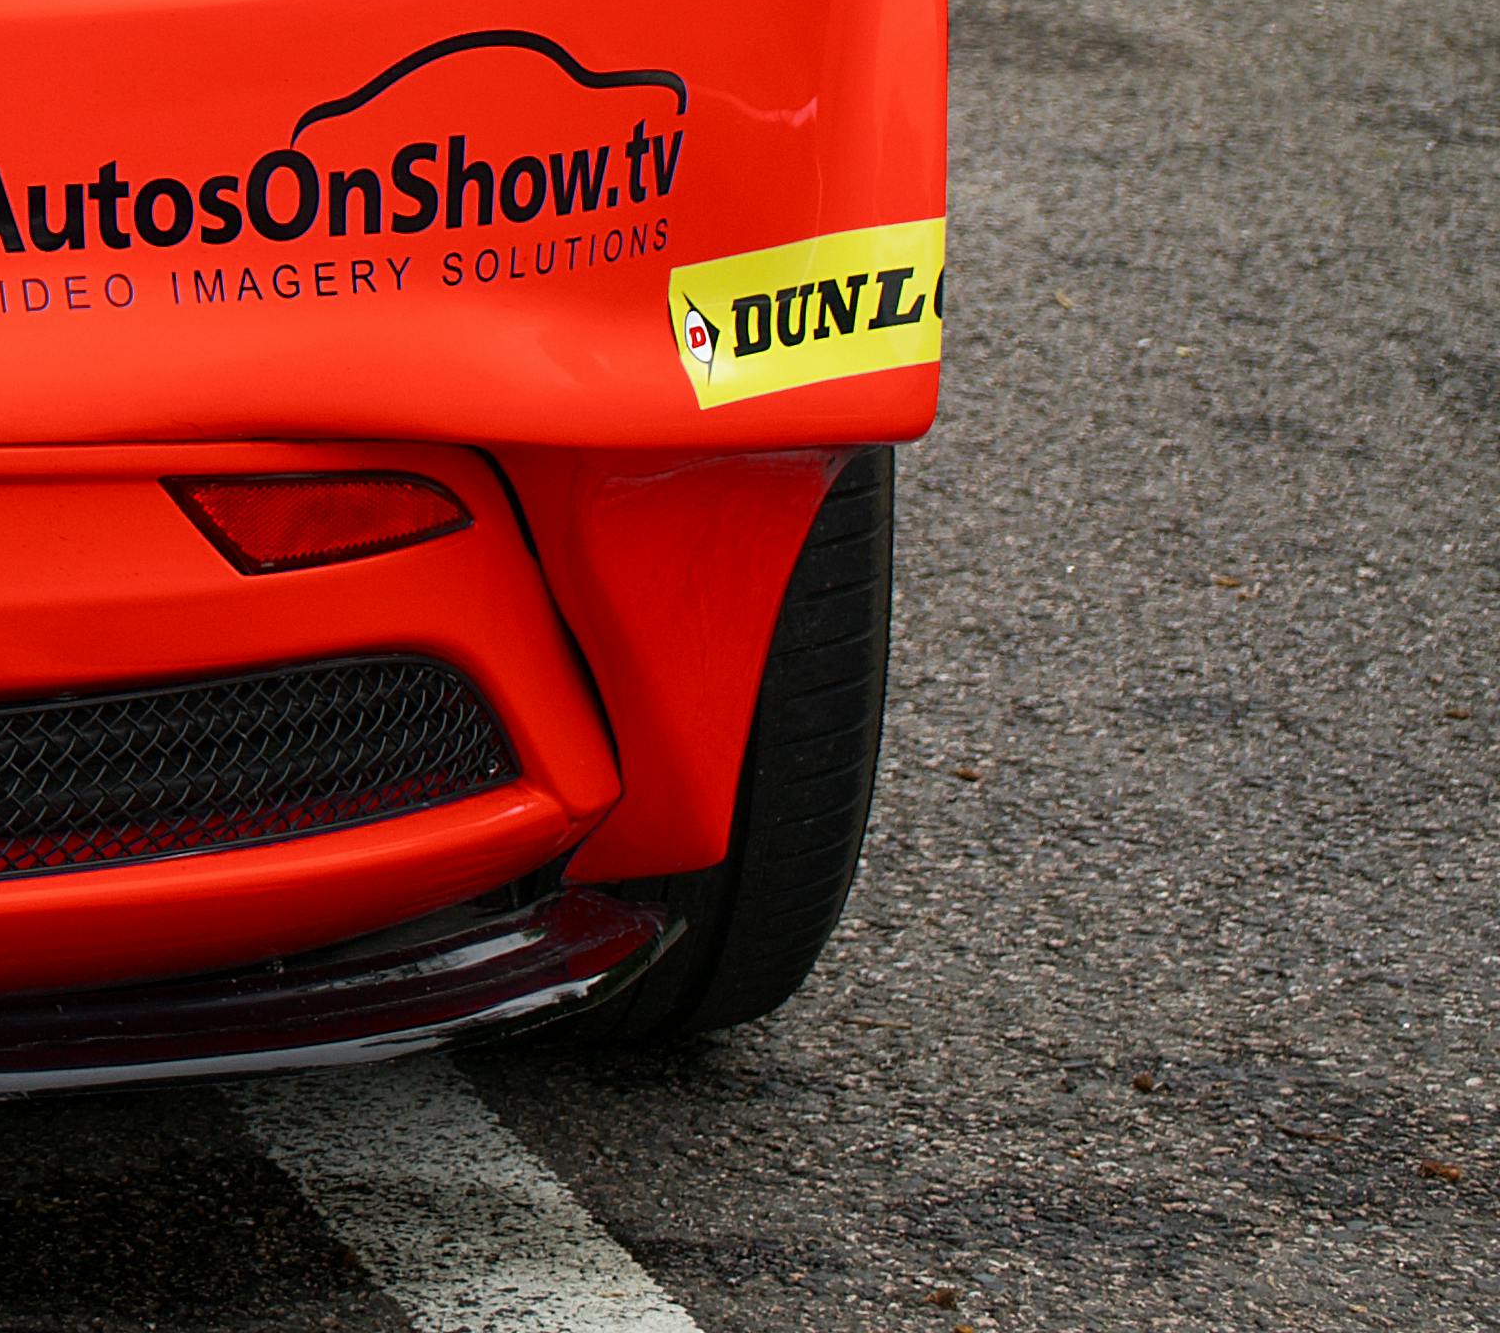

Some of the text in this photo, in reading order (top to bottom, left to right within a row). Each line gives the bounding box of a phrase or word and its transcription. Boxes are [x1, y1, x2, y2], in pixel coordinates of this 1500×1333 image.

[170, 255, 412, 306] IMAGERY
[441, 217, 669, 288] SOLUTIONS
[731, 264, 944, 359] DUNL
